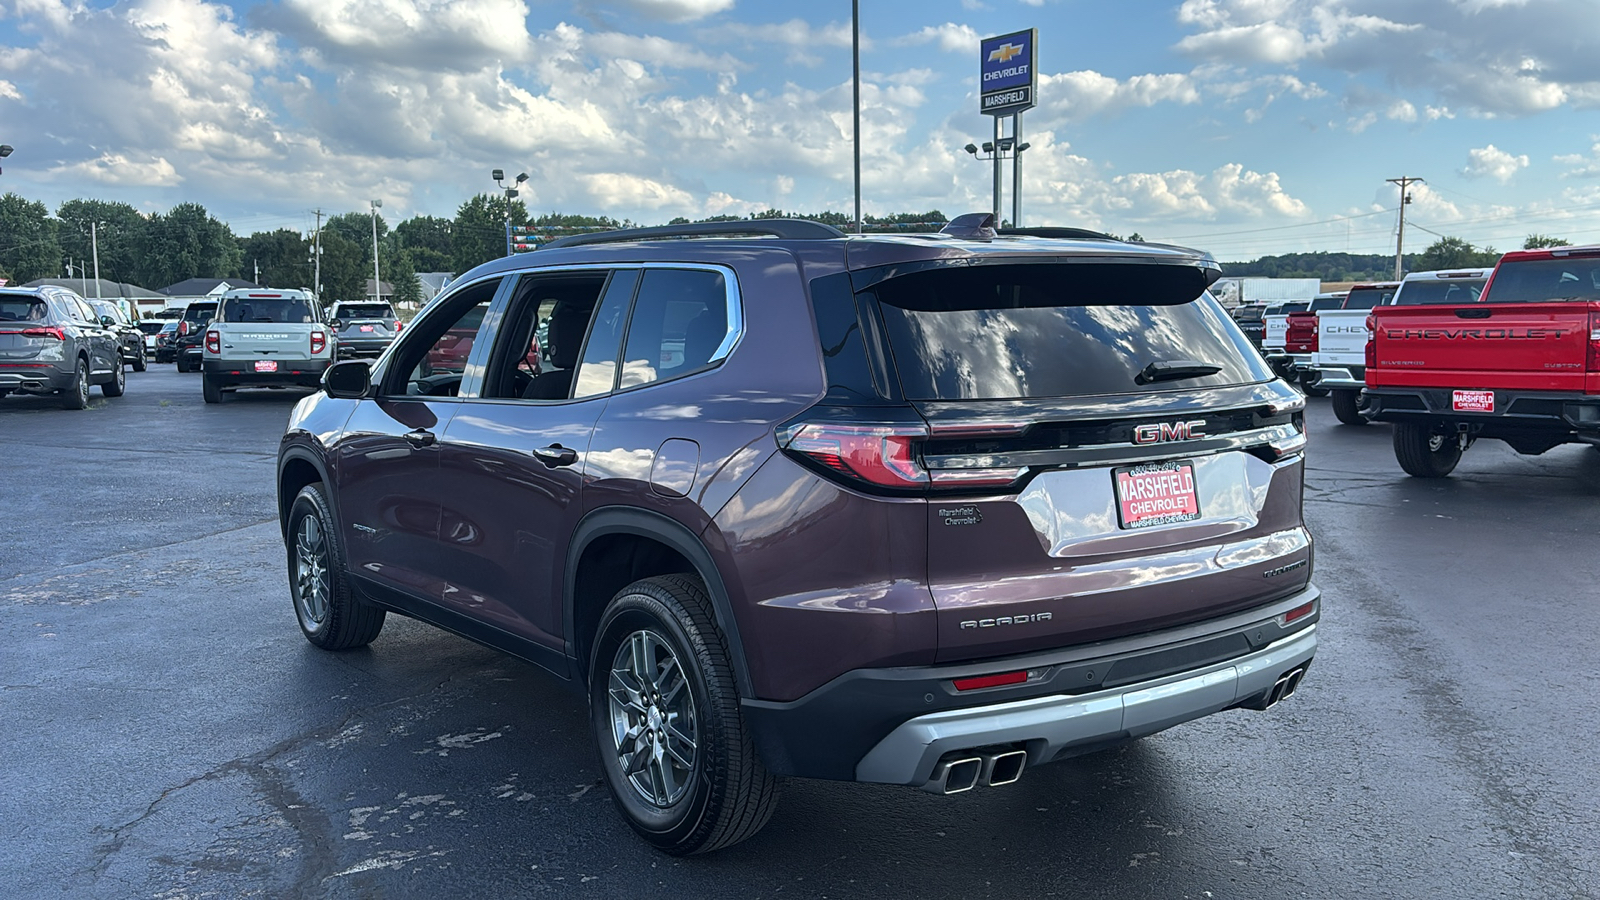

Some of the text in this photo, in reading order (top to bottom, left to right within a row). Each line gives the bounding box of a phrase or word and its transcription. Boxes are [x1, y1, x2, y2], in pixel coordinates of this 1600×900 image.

[983, 65, 1028, 81] CHEVROLET
[985, 91, 1024, 106] MARSHFIELD
[1387, 329, 1569, 340] CHEVROLET
[1453, 395, 1493, 403] MARSHFIELD
[1134, 419, 1206, 444] GMC
[1119, 473, 1194, 502] MARSHFIELD
[1130, 496, 1189, 514] CHEVROLET
[1130, 516, 1164, 528] MARSHFIELD
[1165, 513, 1196, 524] CHEVROLET
[960, 612, 1053, 629] ACADIA
